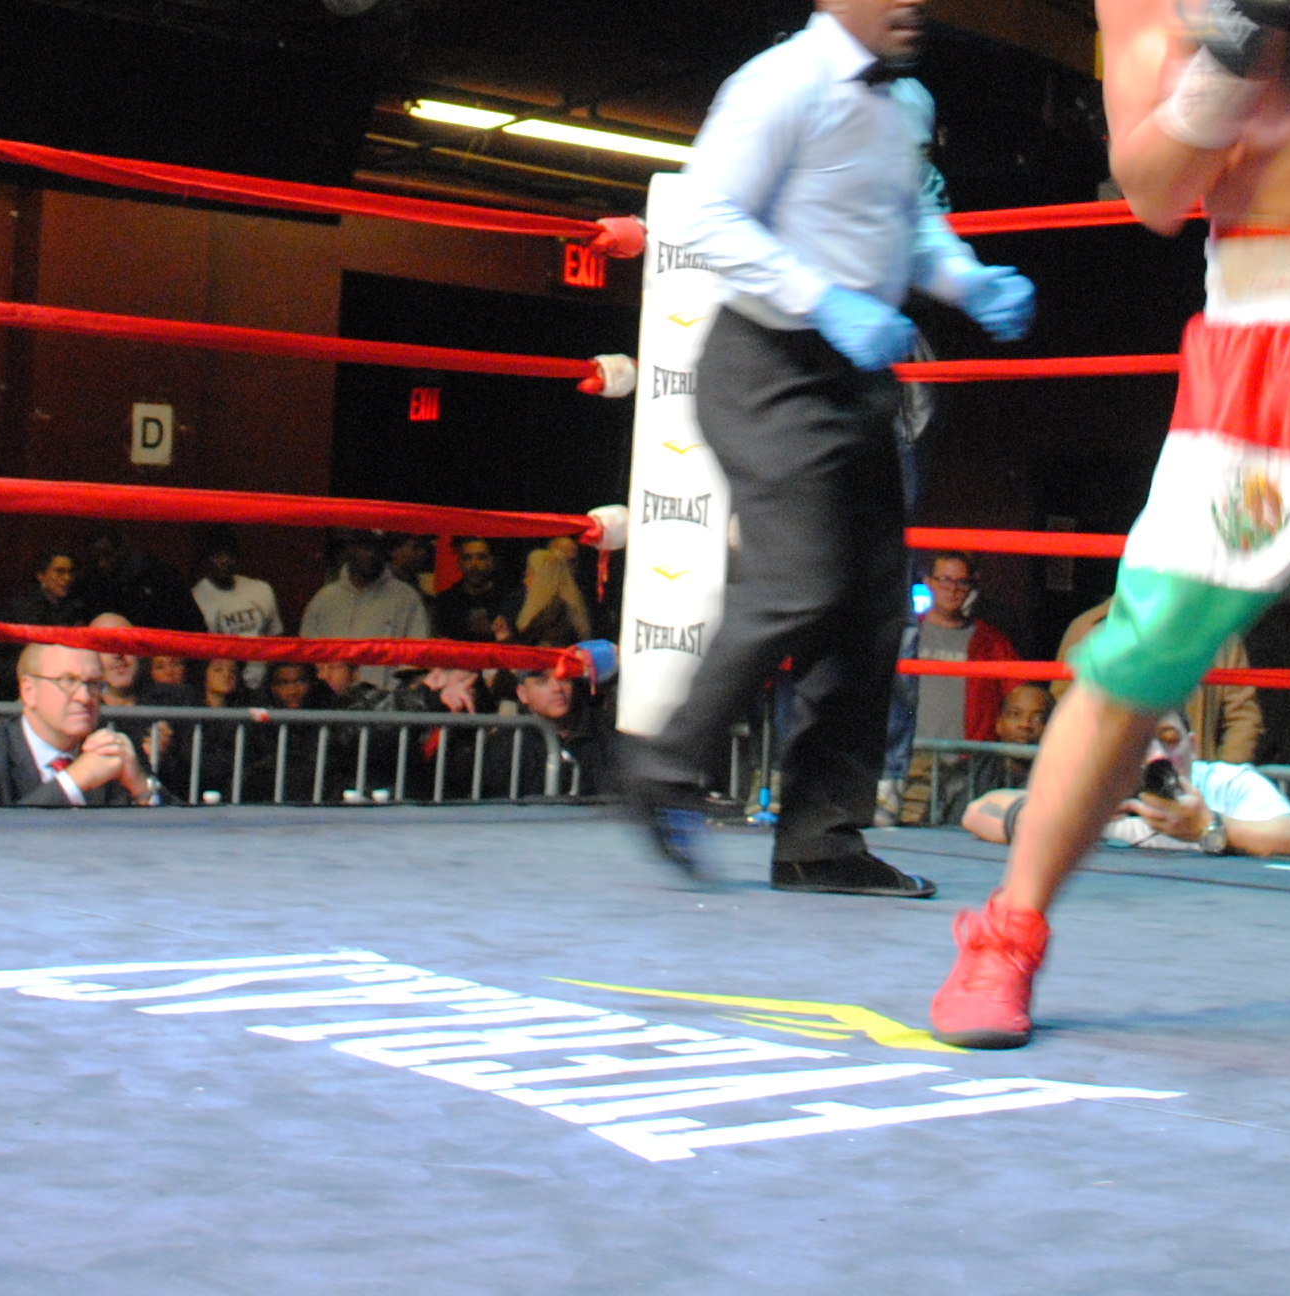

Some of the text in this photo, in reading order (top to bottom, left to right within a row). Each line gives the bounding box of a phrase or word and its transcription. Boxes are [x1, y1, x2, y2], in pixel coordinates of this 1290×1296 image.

[652, 365, 696, 399] EVERL
[142, 416, 164, 449] D
[642, 489, 711, 529] EVERLAST
[634, 619, 705, 656] EVERLAST
